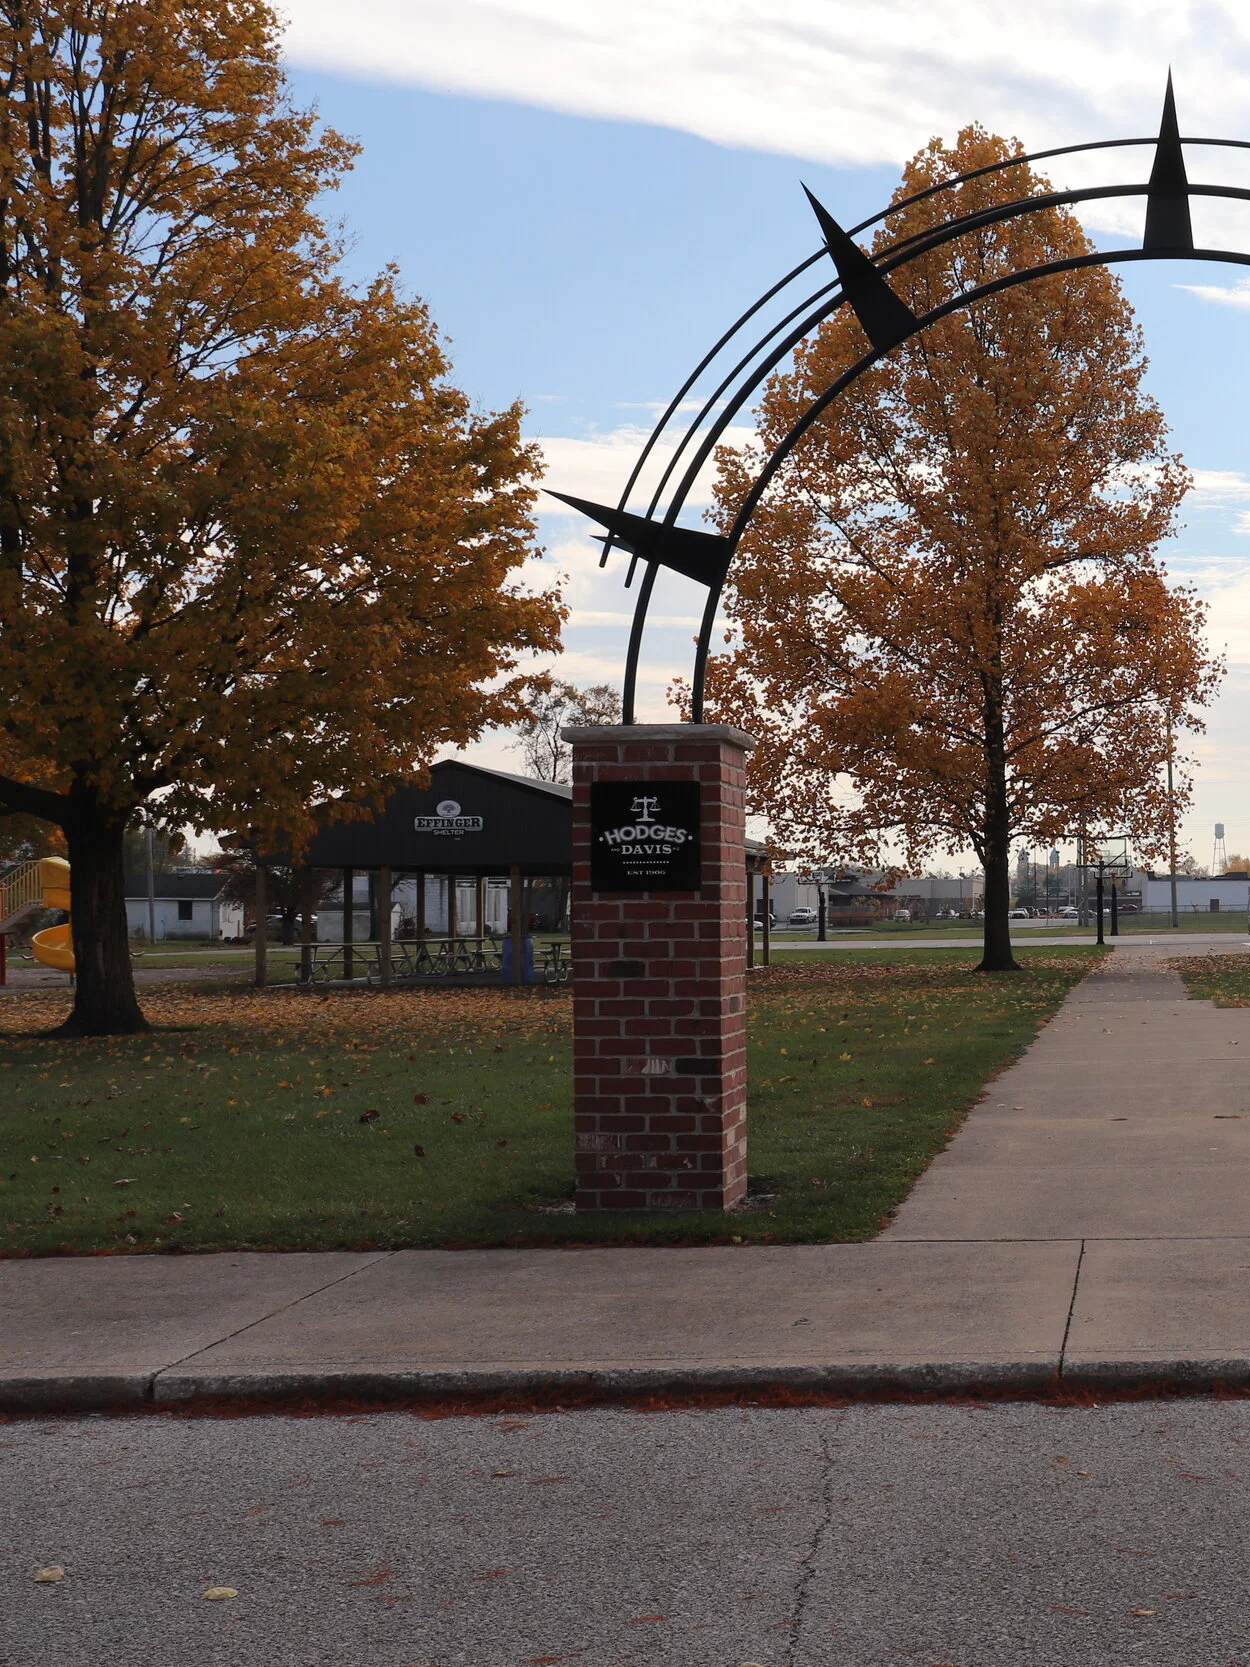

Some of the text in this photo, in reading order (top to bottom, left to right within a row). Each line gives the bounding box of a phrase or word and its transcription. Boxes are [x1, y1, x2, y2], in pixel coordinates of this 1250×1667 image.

[416, 817, 481, 828] EFFINGER
[603, 825, 688, 846] HODGES
[621, 844, 672, 855] DAVIS
